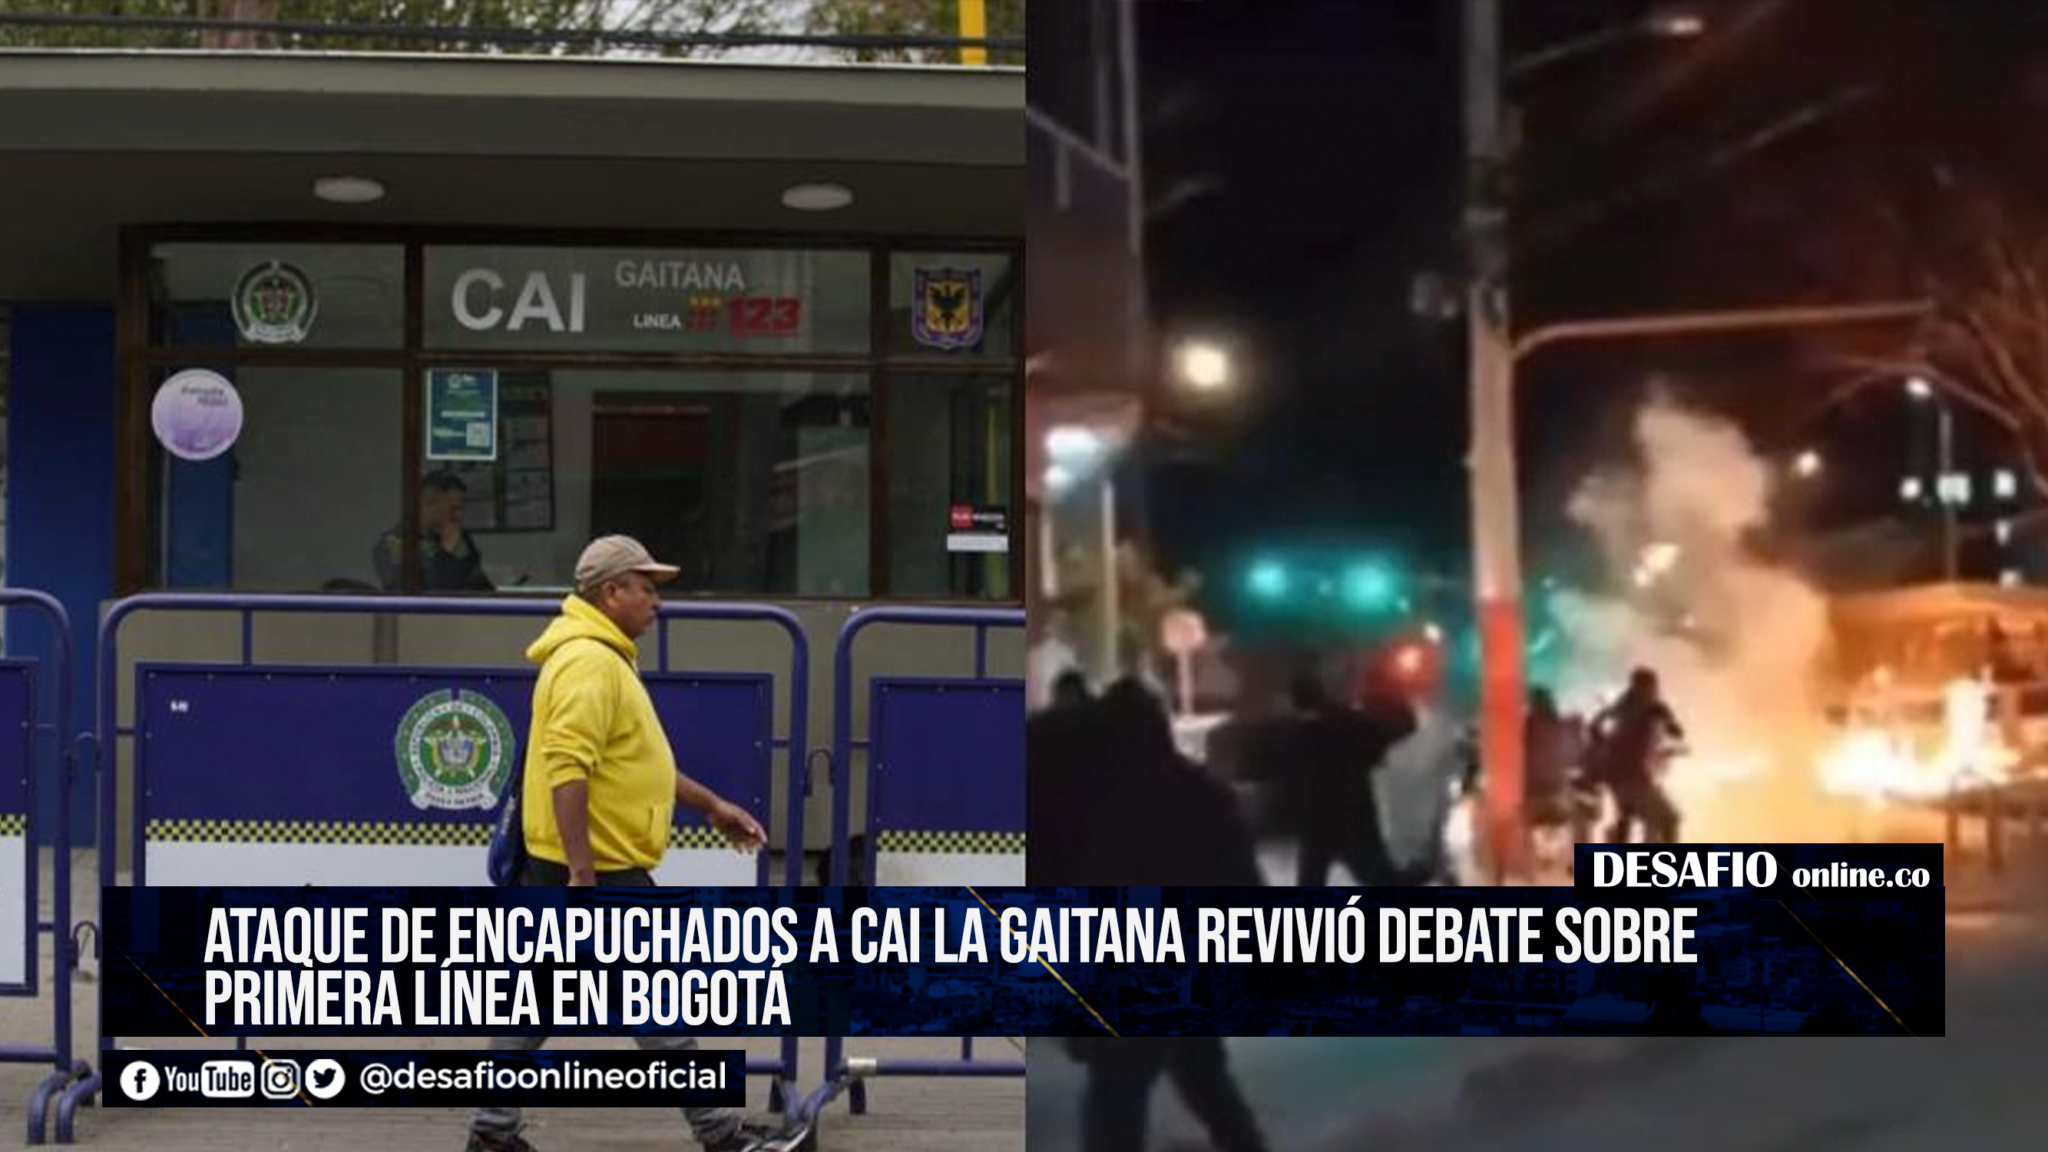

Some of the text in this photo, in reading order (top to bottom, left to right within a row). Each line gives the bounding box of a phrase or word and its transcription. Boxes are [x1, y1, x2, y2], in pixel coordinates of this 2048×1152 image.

[615, 259, 745, 291] GAITANA
[452, 269, 584, 332] CAI
[633, 295, 802, 337] LINEA 123
